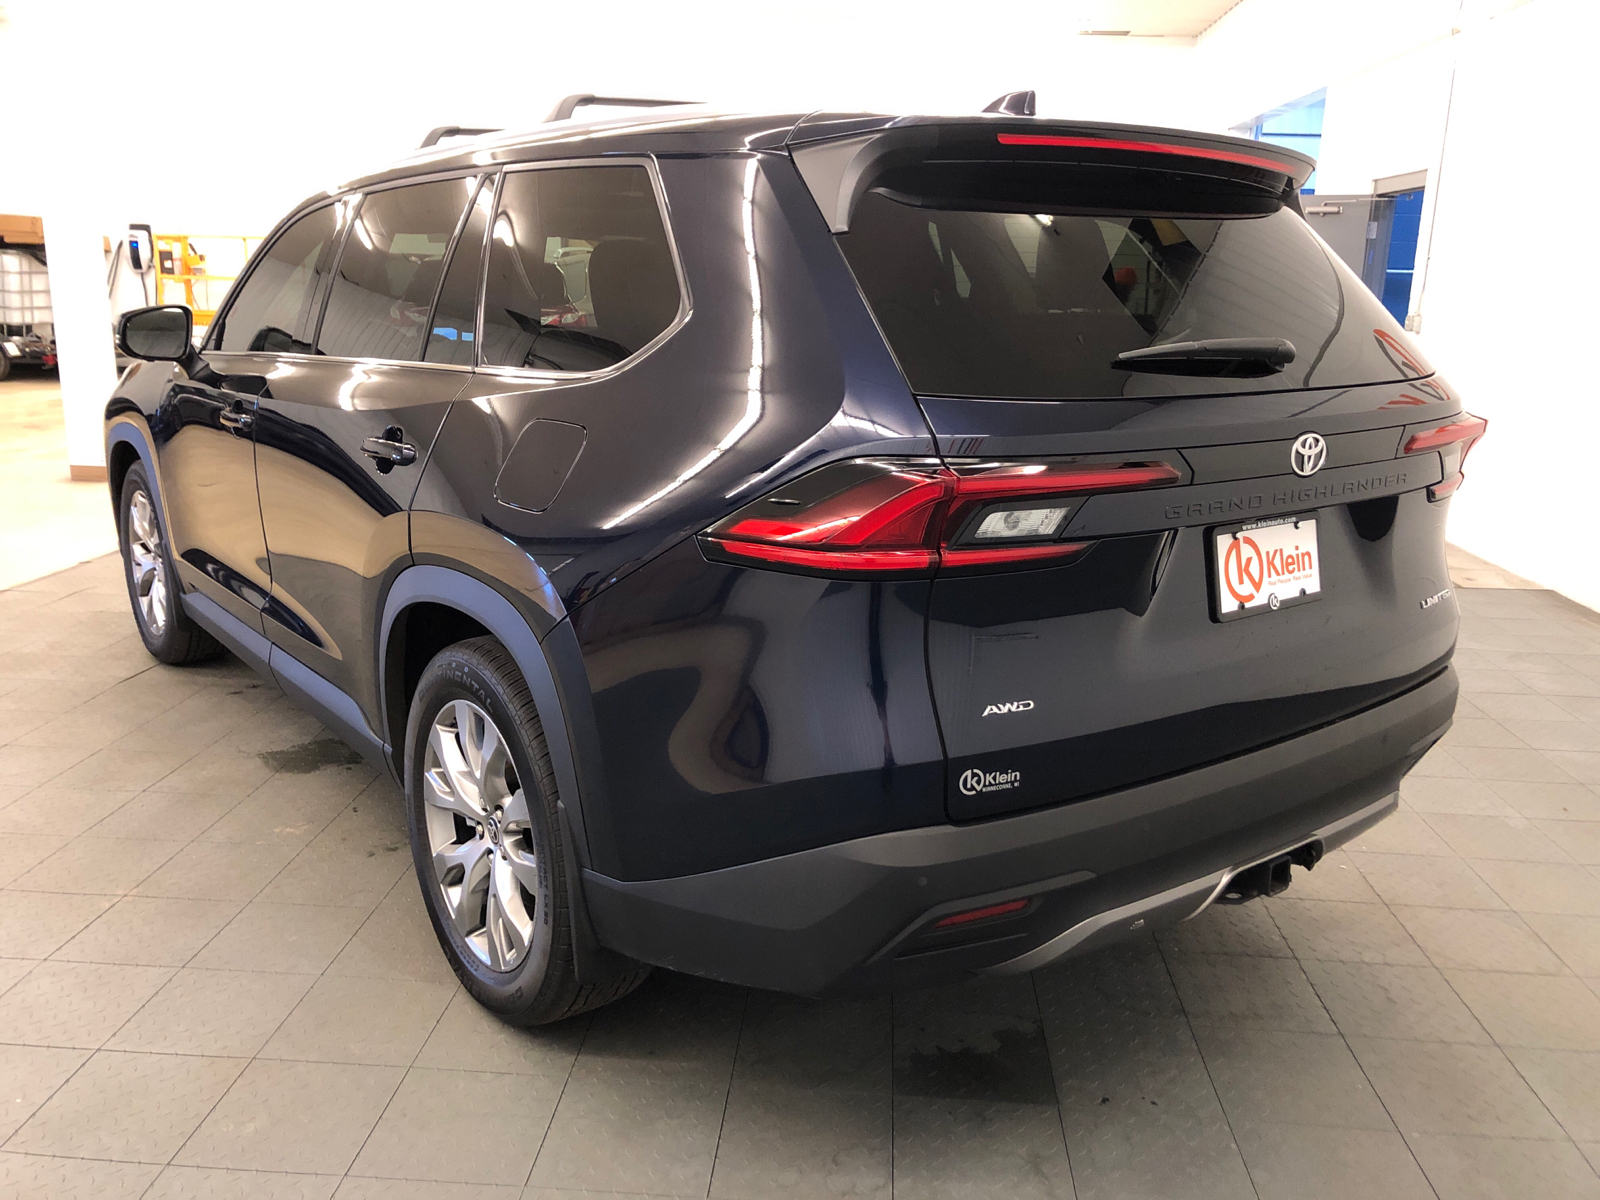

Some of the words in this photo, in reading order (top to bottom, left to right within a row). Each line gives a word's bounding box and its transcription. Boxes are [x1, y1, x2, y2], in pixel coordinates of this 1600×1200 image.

[1164, 495, 1262, 520] GRAND
[1272, 473, 1408, 506] HIGHLANDER
[1242, 517, 1297, 531] www.kleinauto.com
[1266, 545, 1313, 578] Klein
[981, 699, 1034, 717] AWD
[985, 769, 1020, 785] Klein
